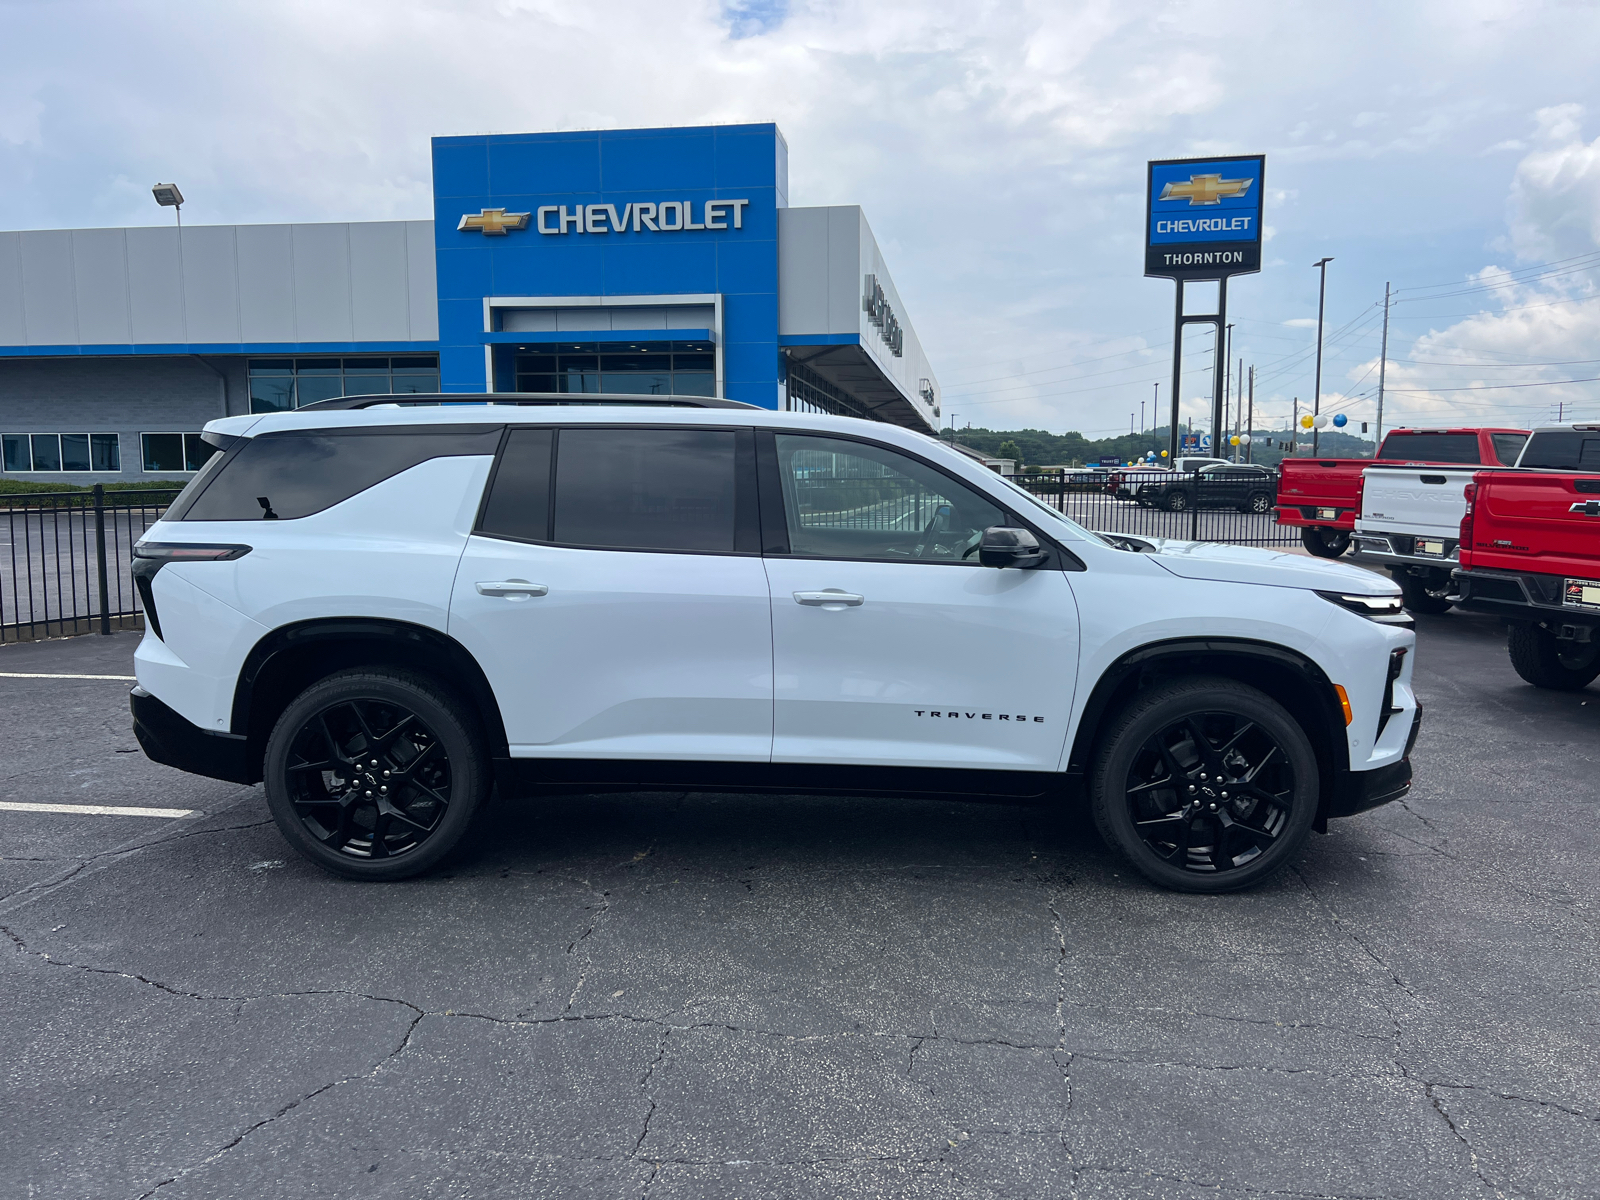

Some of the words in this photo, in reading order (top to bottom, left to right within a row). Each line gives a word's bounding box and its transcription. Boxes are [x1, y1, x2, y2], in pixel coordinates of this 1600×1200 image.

[537, 198, 749, 235] CHEVROLET
[1157, 217, 1251, 233] CHEVROLET
[1164, 251, 1243, 265] THORNTON
[1476, 542, 1530, 551] SILVERADO
[914, 710, 1045, 723] TRAVERSE
